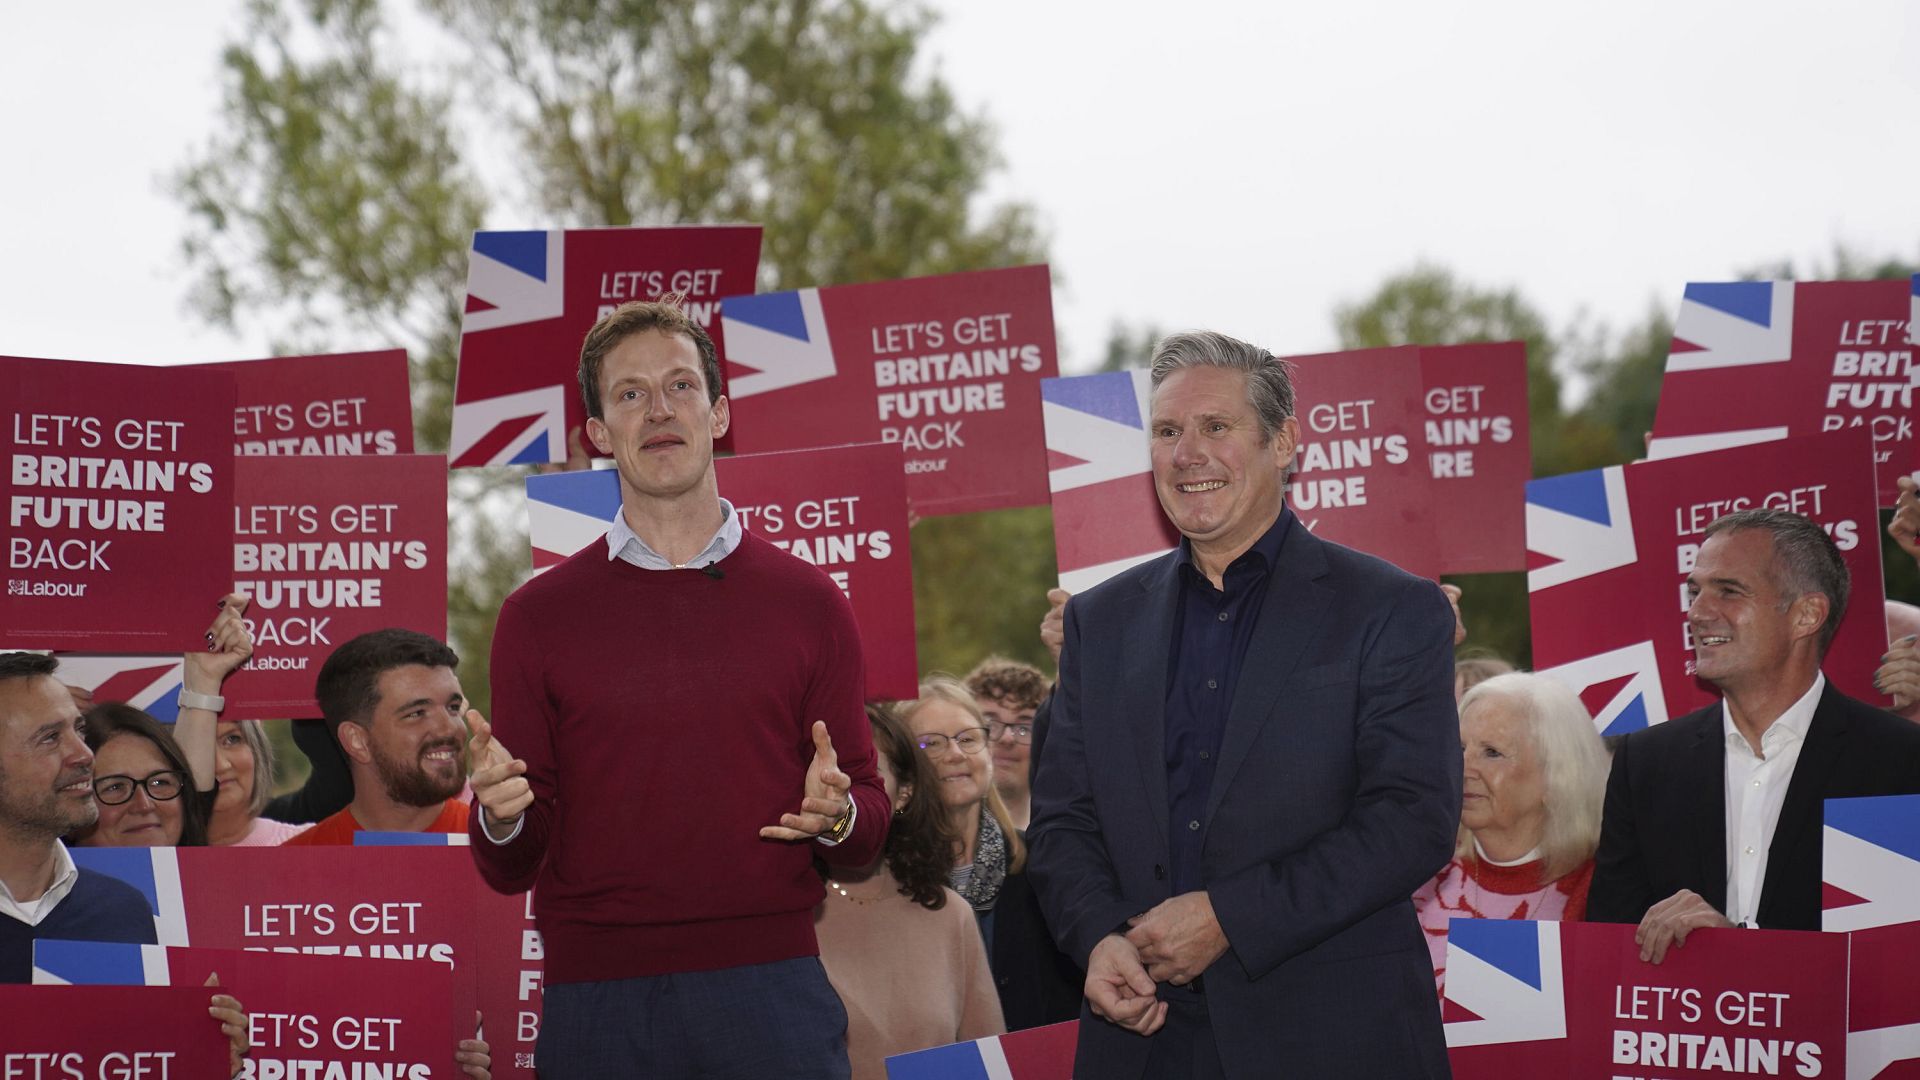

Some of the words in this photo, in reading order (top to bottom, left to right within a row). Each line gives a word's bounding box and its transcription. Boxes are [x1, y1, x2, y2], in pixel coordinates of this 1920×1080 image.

[601, 270, 663, 298] LET'S
[671, 269, 722, 296] GET
[872, 320, 945, 354] LET'S
[953, 313, 1012, 346] GET
[874, 345, 1042, 388] BRITAIN'S
[234, 404, 295, 435] ET'S
[305, 397, 367, 428] GET
[878, 382, 1005, 421] FUTURE
[1308, 399, 1375, 433] GET
[1425, 385, 1485, 415] GET
[13, 413, 101, 449] LET'S
[114, 418, 185, 452] GET
[1425, 416, 1514, 446] AIN'S
[904, 458, 948, 474] abour
[1293, 434, 1409, 473] AIN'S
[11, 454, 214, 494] BRITAIN'S
[10, 495, 165, 532] FUTURE
[234, 504, 318, 534] LET'S
[330, 504, 399, 534] GET
[736, 504, 784, 533] T'S
[794, 496, 860, 529] GET
[9, 537, 111, 572] BACK
[234, 540, 428, 572] BRITAIN'S
[774, 530, 892, 566] AIN'S
[25, 580, 87, 597] Labour
[250, 656, 309, 671] Labour
[244, 903, 336, 937] LET'S
[348, 902, 422, 935] GET
[1615, 985, 1702, 1023] LET'S
[1715, 990, 1791, 1028] GET
[248, 1012, 320, 1049] ET'S
[332, 1016, 402, 1052] GET
[4, 1051, 85, 1080] ET'S
[1612, 1029, 1823, 1079] BRITAIN'S
